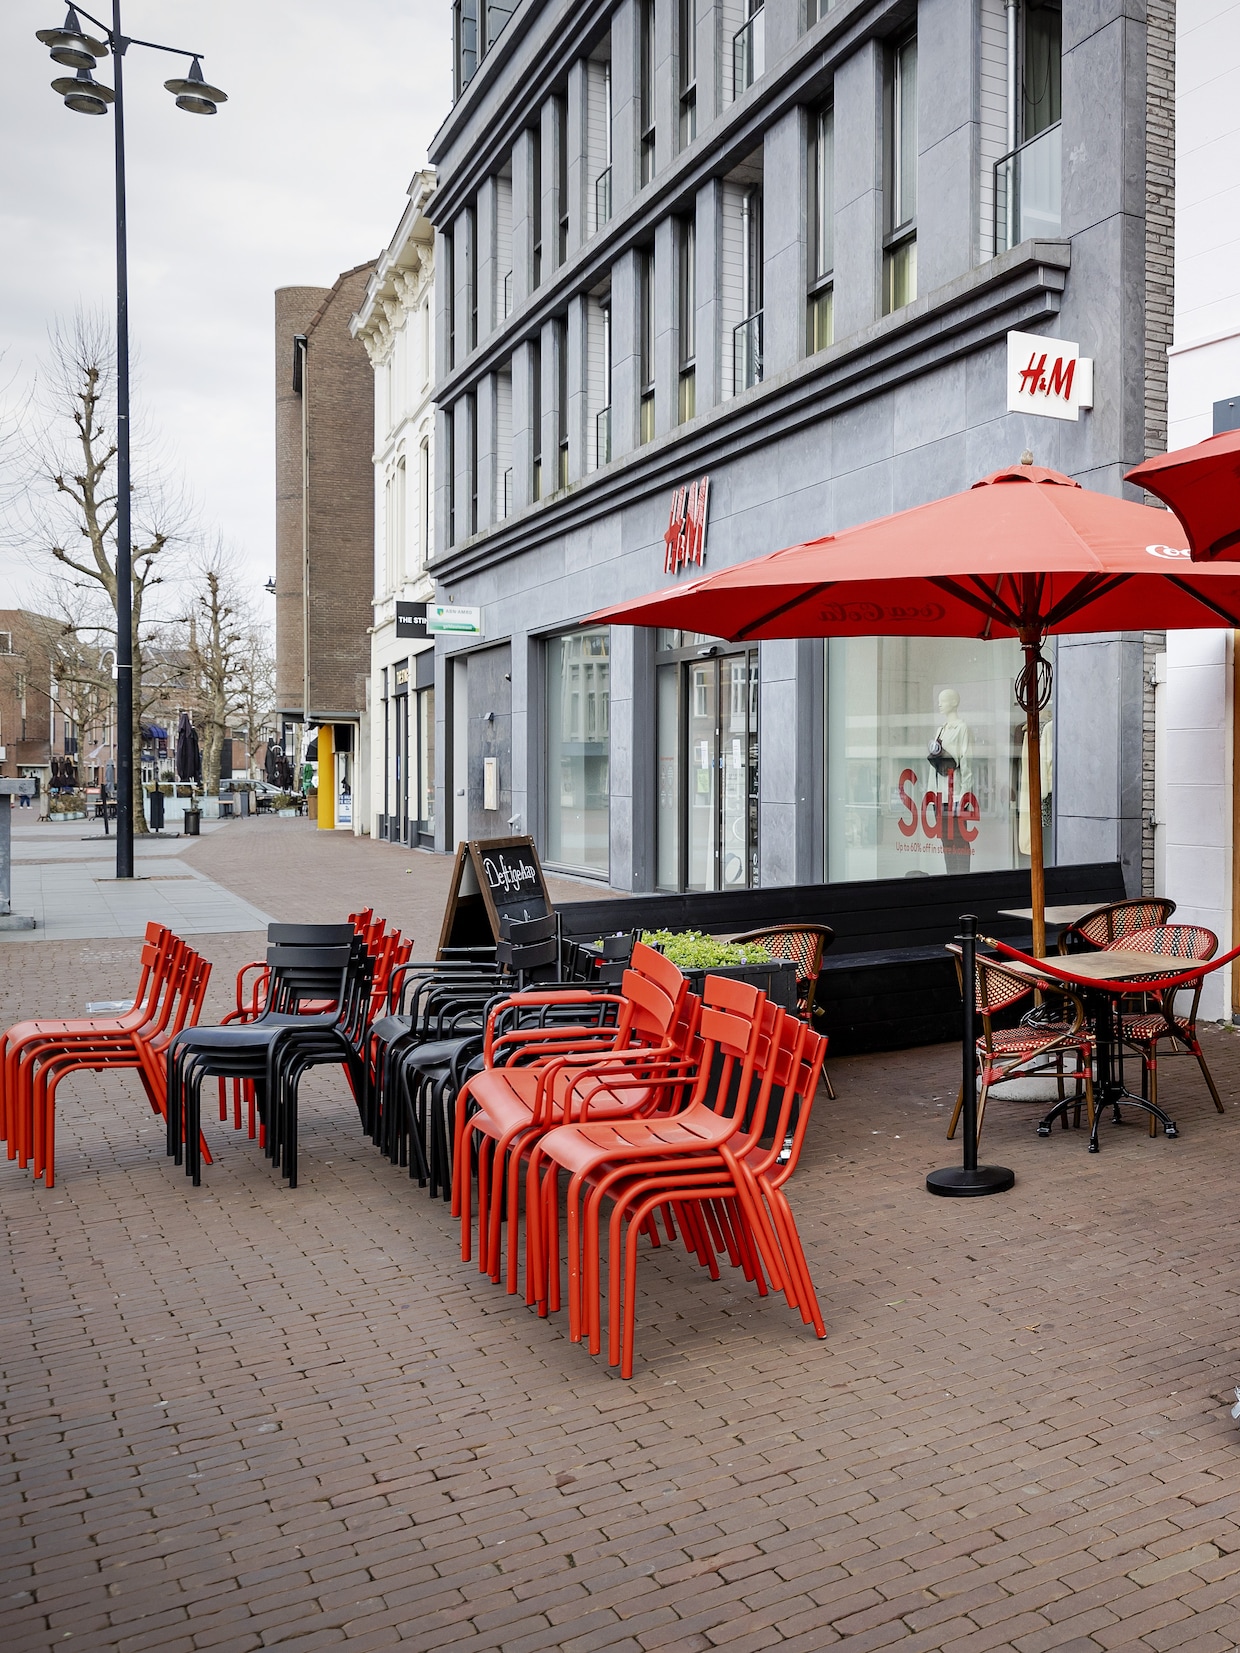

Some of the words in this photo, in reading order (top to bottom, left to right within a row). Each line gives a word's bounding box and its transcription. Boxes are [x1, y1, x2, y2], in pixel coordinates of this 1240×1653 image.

[1019, 352, 1076, 401] H&M
[664, 475, 710, 575] H&M
[398, 616, 412, 624] THE
[898, 768, 981, 842] Sale
[896, 842, 904, 855] Up
